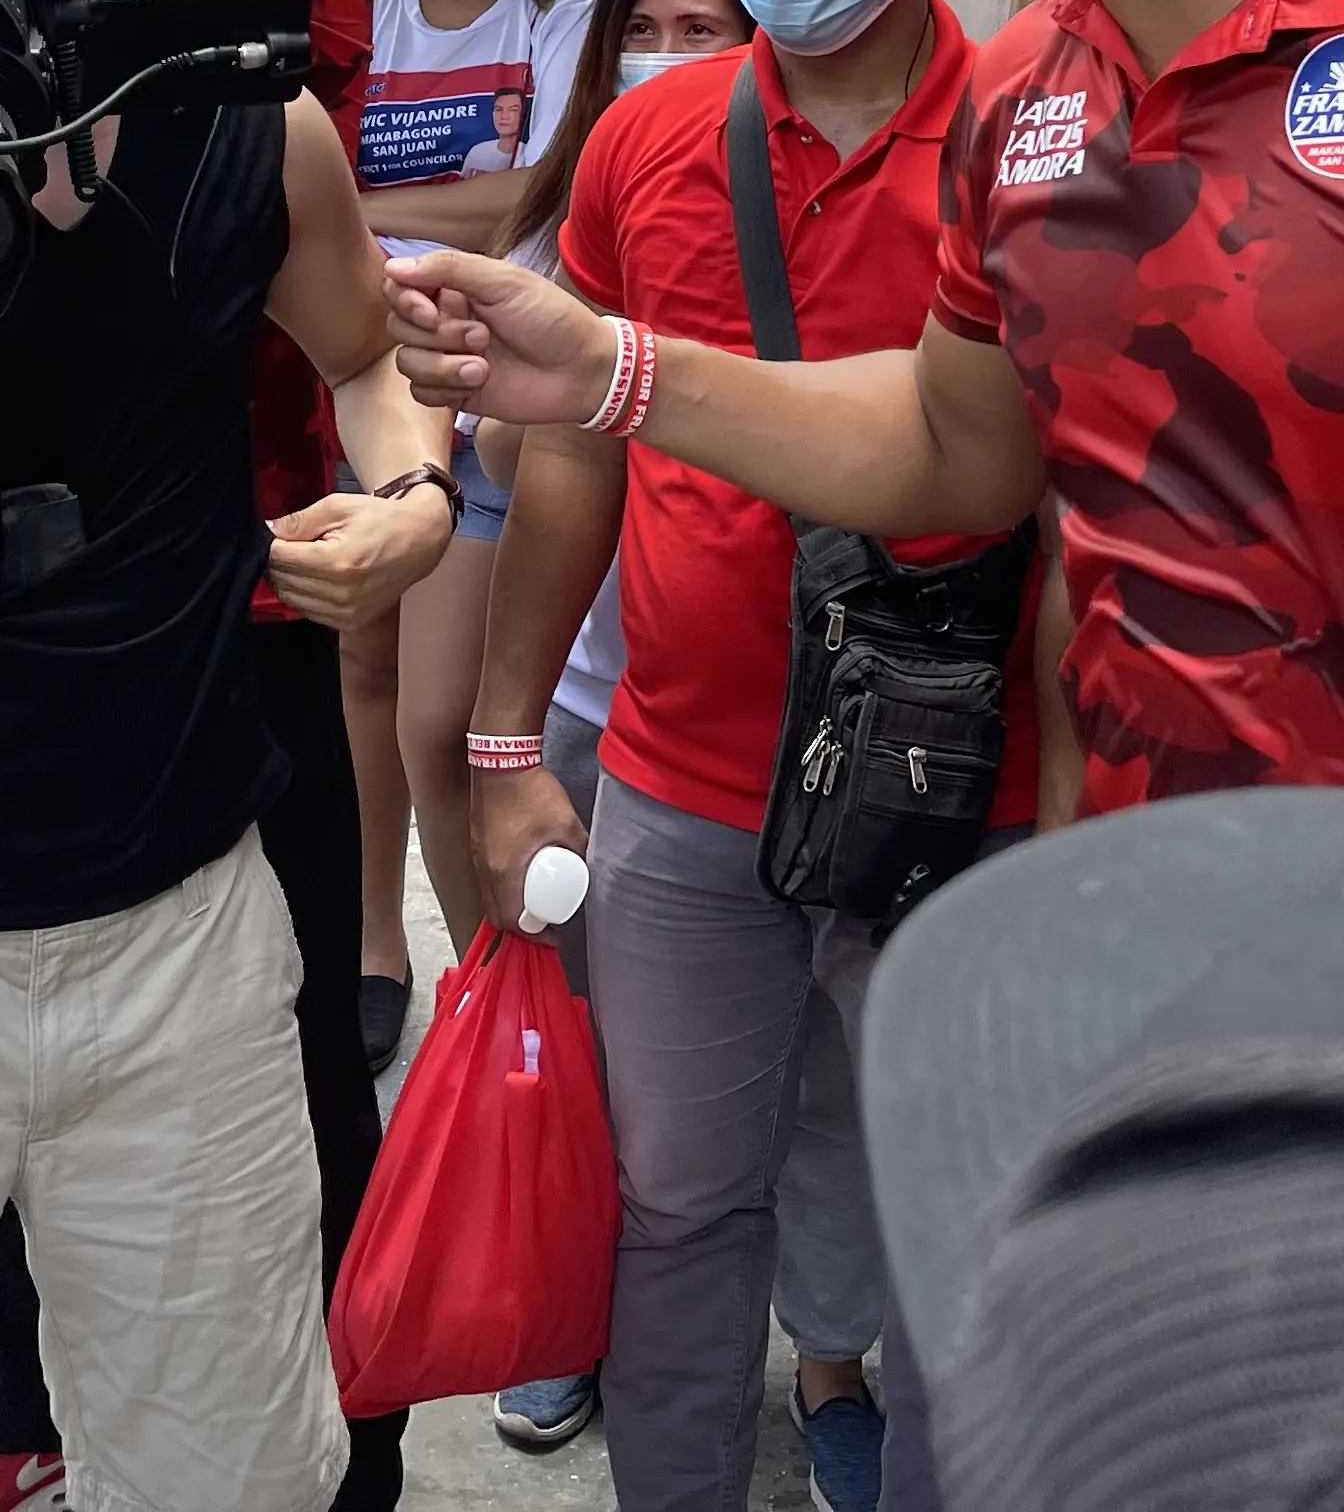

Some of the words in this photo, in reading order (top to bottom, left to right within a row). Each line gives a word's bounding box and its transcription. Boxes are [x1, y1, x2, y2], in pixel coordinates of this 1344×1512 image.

[391, 104, 478, 128] VIJANDRE
[372, 145, 398, 158] SAN
[400, 139, 437, 157] JUAN
[402, 153, 464, 169] COUNCILOR
[1317, 156, 1342, 167] SAN
[637, 332, 656, 402] MAYOR
